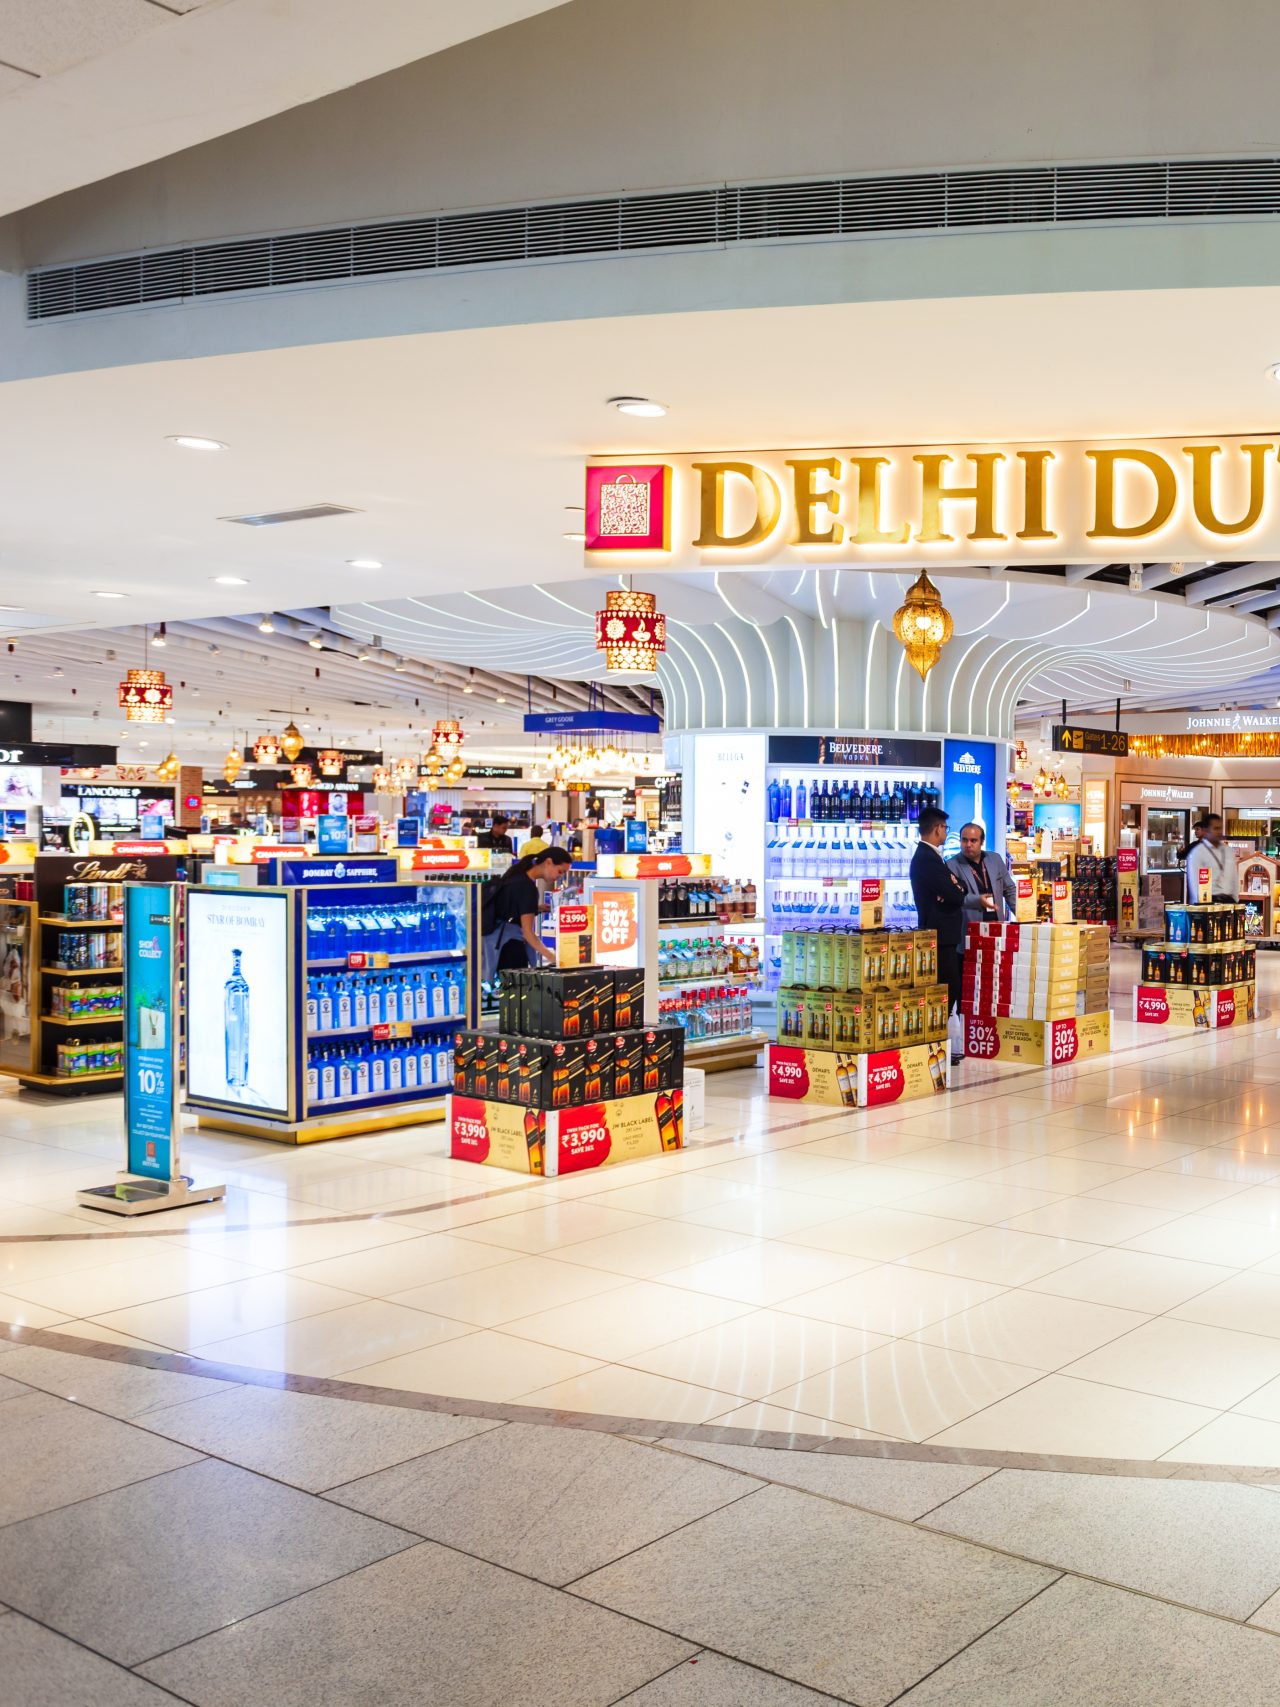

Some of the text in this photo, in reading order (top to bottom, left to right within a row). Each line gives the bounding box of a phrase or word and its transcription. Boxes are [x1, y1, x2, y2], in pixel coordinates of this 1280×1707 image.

[692, 450, 1058, 548] DELHI
[1187, 717, 1231, 729] JOHNNIE
[829, 741, 883, 755] BELVEDERE
[1101, 733, 1126, 751] 1-26
[953, 762, 982, 775] BELVEDERE
[78, 787, 131, 797] LANCÔME
[1140, 787, 1194, 799] JOHNNIE WALKER
[422, 855, 459, 864] LIQUEURS
[658, 862, 672, 871] GIN
[66, 861, 132, 880] Lindt
[303, 868, 334, 878] BOMBAY
[560, 914, 586, 923] ₹3,990
[602, 909, 629, 927] 30%
[601, 927, 629, 944] OFF
[1139, 1001, 1166, 1011] ₹4,990
[1217, 1003, 1234, 1012] ₹4,990
[969, 1026, 994, 1041] 30%
[1055, 1028, 1074, 1046] 30%
[969, 1041, 994, 1055] OFF
[1054, 1043, 1074, 1060] OFF
[772, 1064, 802, 1078] ₹4,990
[868, 1069, 897, 1083] ₹4,990
[621, 1119, 637, 1128] BLACK
[638, 1116, 653, 1124] LABEL
[454, 1121, 486, 1138] ₹3,990
[567, 1126, 578, 1134] TWIN
[561, 1128, 605, 1148] ₹3,990
[571, 1147, 584, 1155] SAVE
